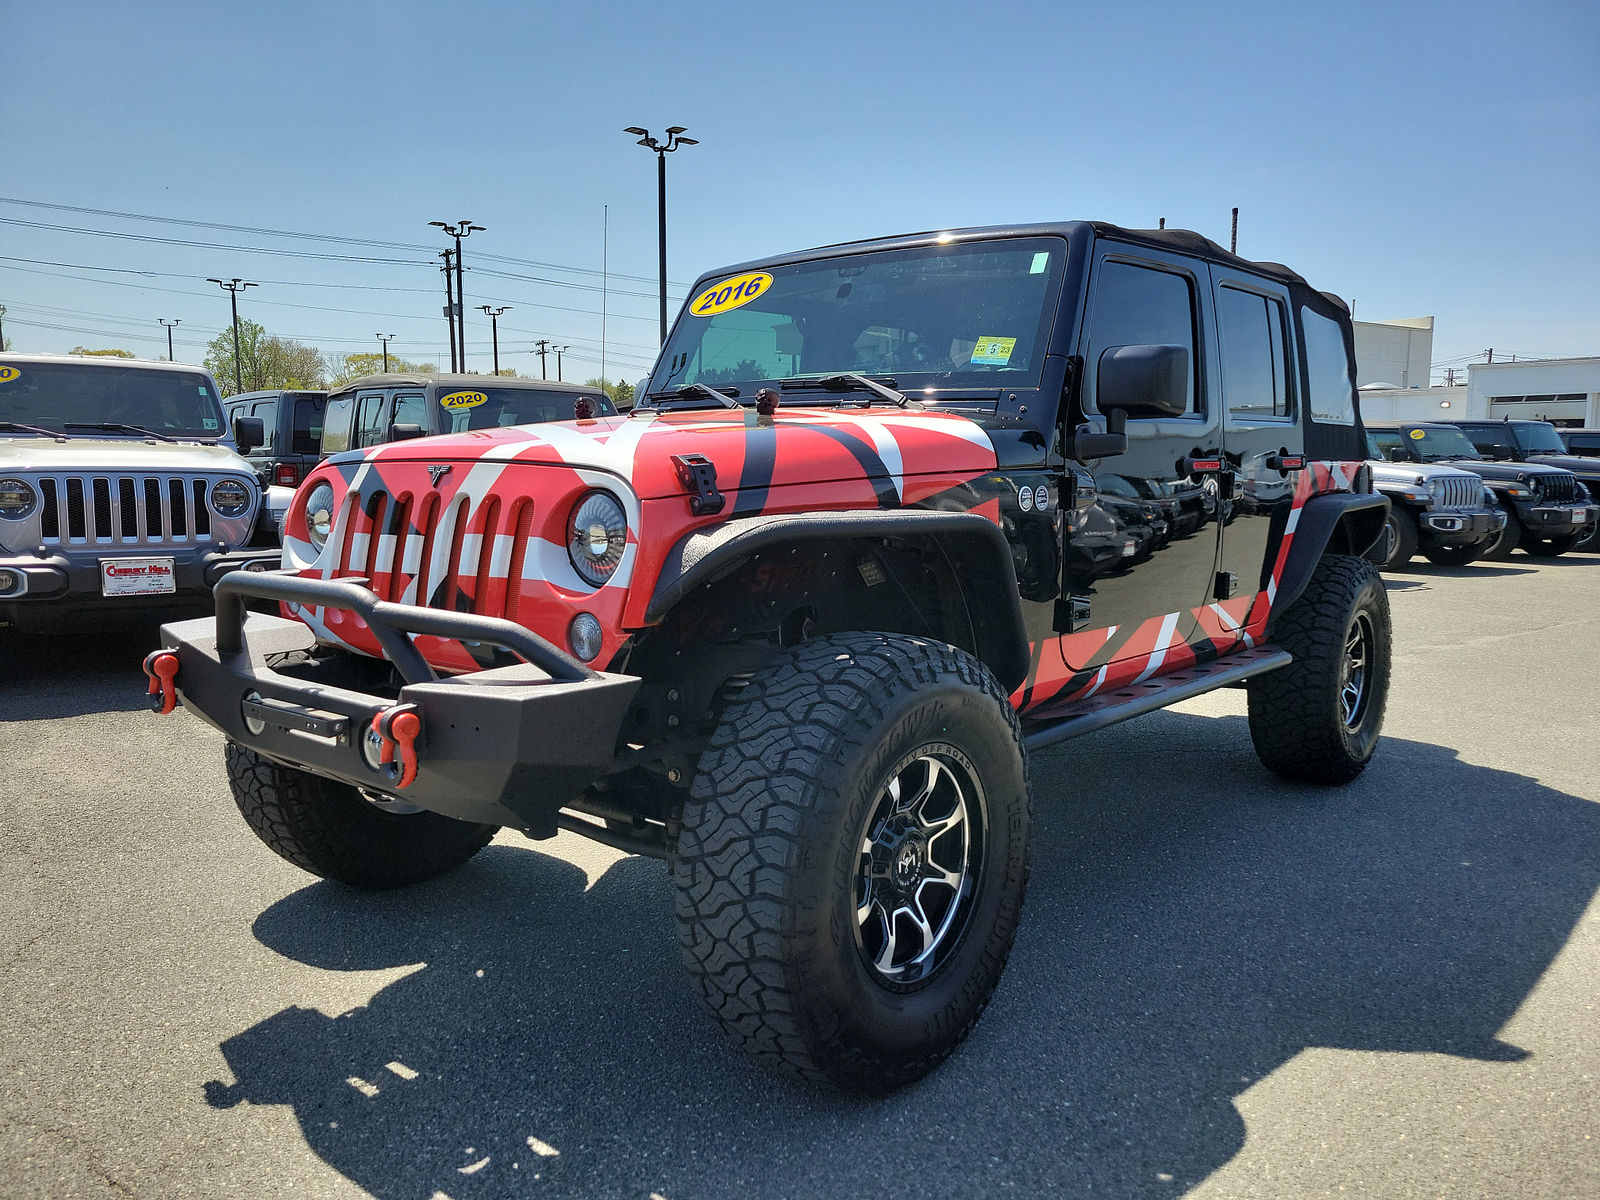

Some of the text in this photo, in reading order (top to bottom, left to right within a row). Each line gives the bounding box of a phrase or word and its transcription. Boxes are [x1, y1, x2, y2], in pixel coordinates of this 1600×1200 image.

[697, 276, 764, 313] 2016
[990, 344, 997, 354] 5
[1000, 346, 1011, 354] 23
[0, 368, 12, 379] 0
[447, 393, 482, 406] 2020
[148, 565, 170, 575] HILL
[877, 700, 944, 765] POWER
[883, 745, 972, 791] MOTIV OFF ROAD
